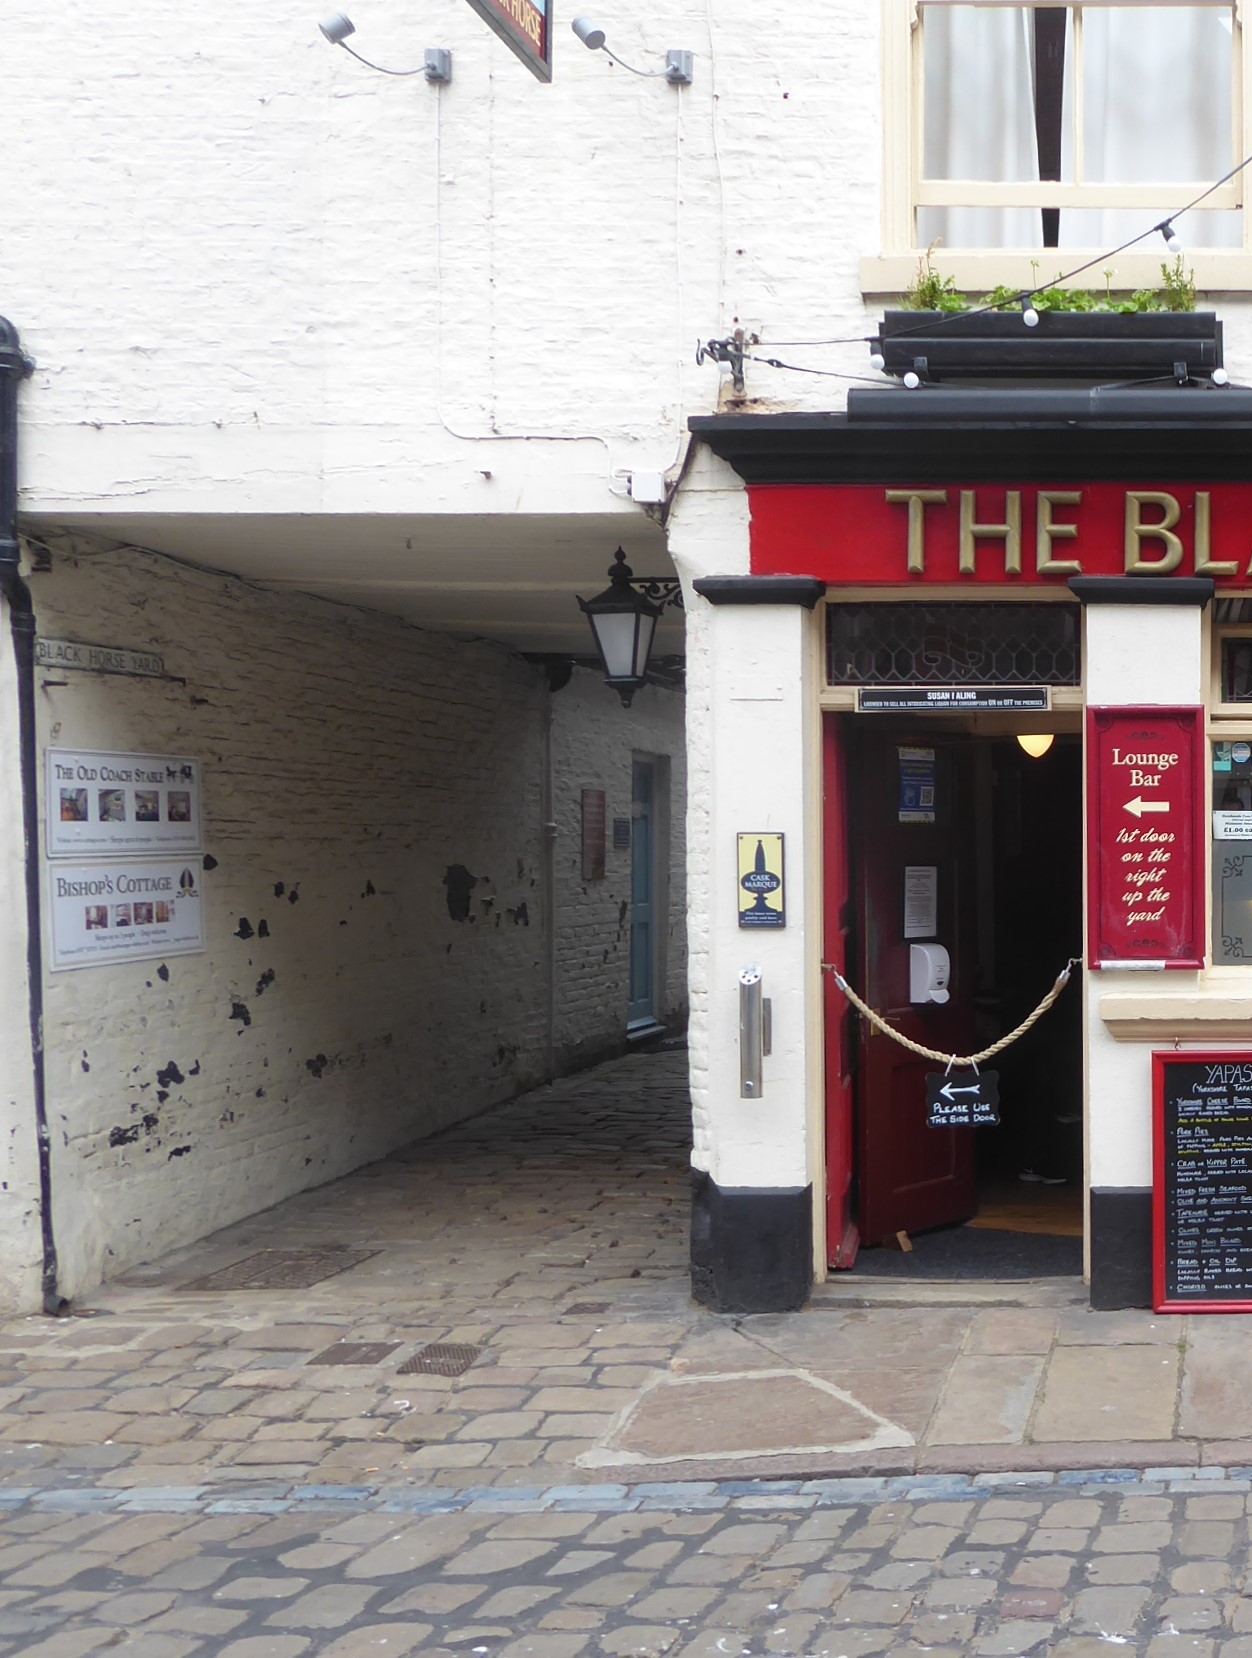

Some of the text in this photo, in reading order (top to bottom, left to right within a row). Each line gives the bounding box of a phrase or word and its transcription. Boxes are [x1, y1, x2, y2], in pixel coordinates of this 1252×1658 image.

[885, 489, 1082, 575] THE
[39, 643, 160, 674] BLACK HORSE YARD
[927, 692, 950, 700] SUSAN
[955, 692, 976, 700] ALING
[1112, 749, 1179, 770] Lounge
[1130, 770, 1162, 787] Bar
[1116, 828, 1176, 842] 1st door
[1121, 848, 1171, 863] on the
[744, 881, 778, 889] MARQUE
[750, 874, 771, 882] CASK
[1125, 867, 1166, 888] right
[1122, 887, 1170, 907] up the
[1127, 907, 1165, 926] yard
[933, 1102, 990, 1113] PLEASE USE
[930, 1113, 996, 1124] THE SIDE DOOR
[1206, 1158, 1227, 1166] KIPPER
